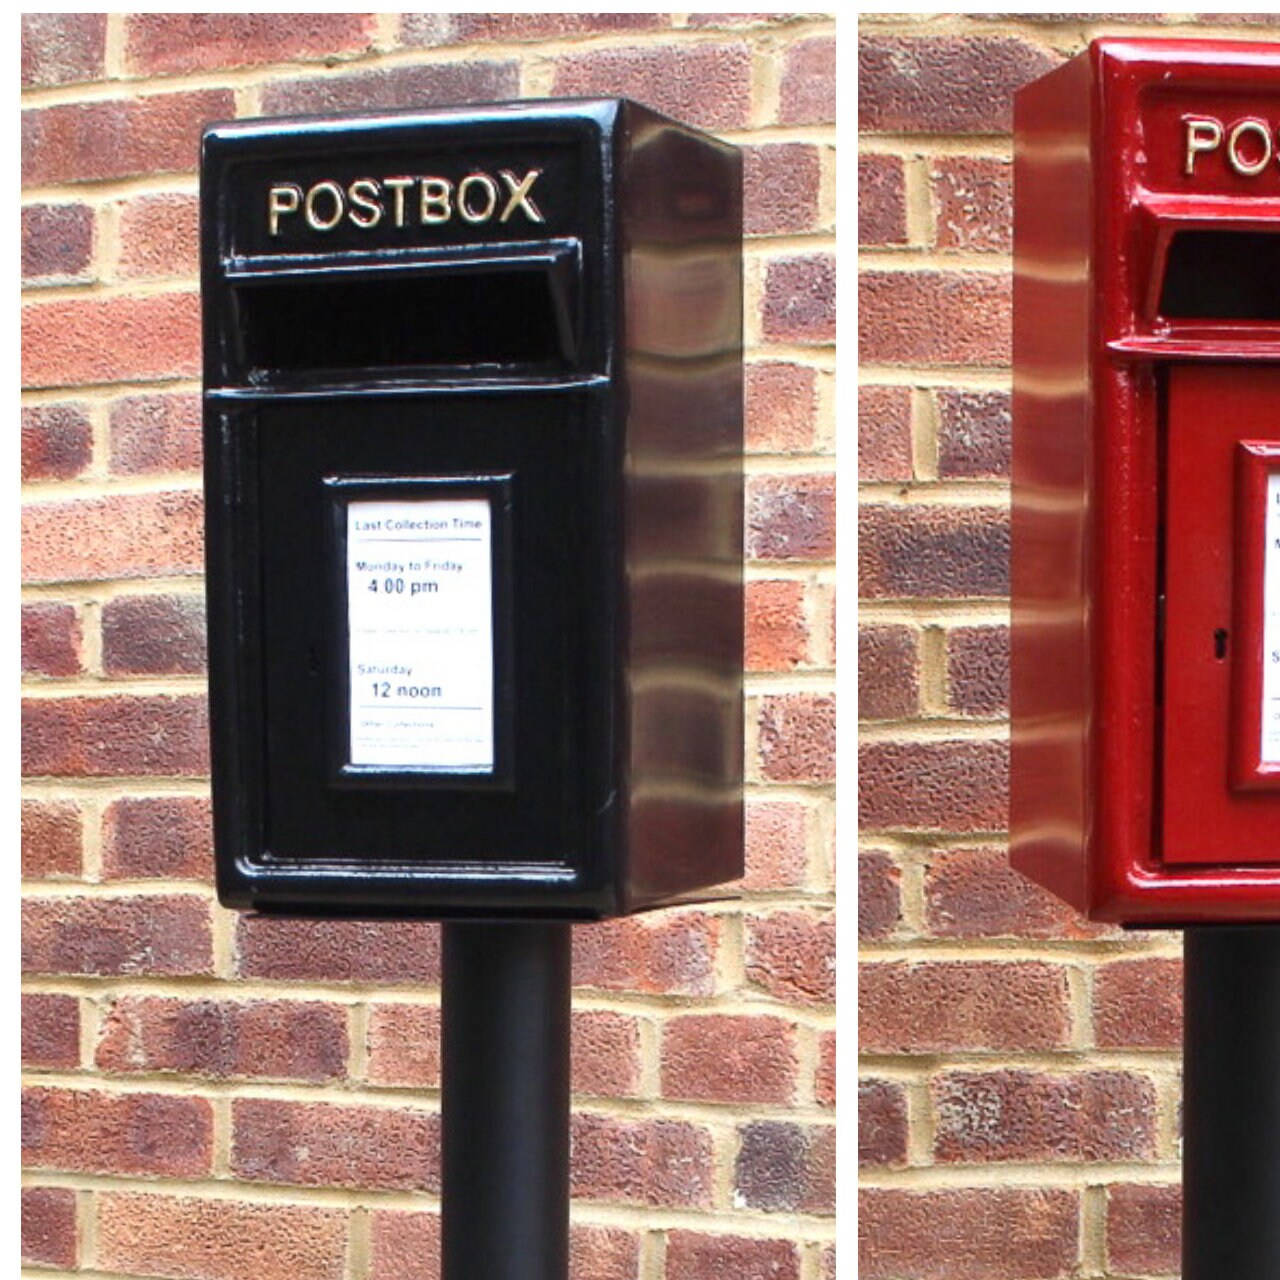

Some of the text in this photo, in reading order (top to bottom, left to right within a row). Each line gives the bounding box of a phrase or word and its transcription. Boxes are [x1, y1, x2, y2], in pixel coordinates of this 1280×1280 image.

[268, 169, 545, 236] POSTBOX
[355, 518, 483, 531] Last Collection Time
[356, 560, 463, 573] Monday to Friday
[368, 578, 439, 596] 400 pm
[357, 664, 413, 676] Saturday
[372, 682, 442, 698] 12 noon
